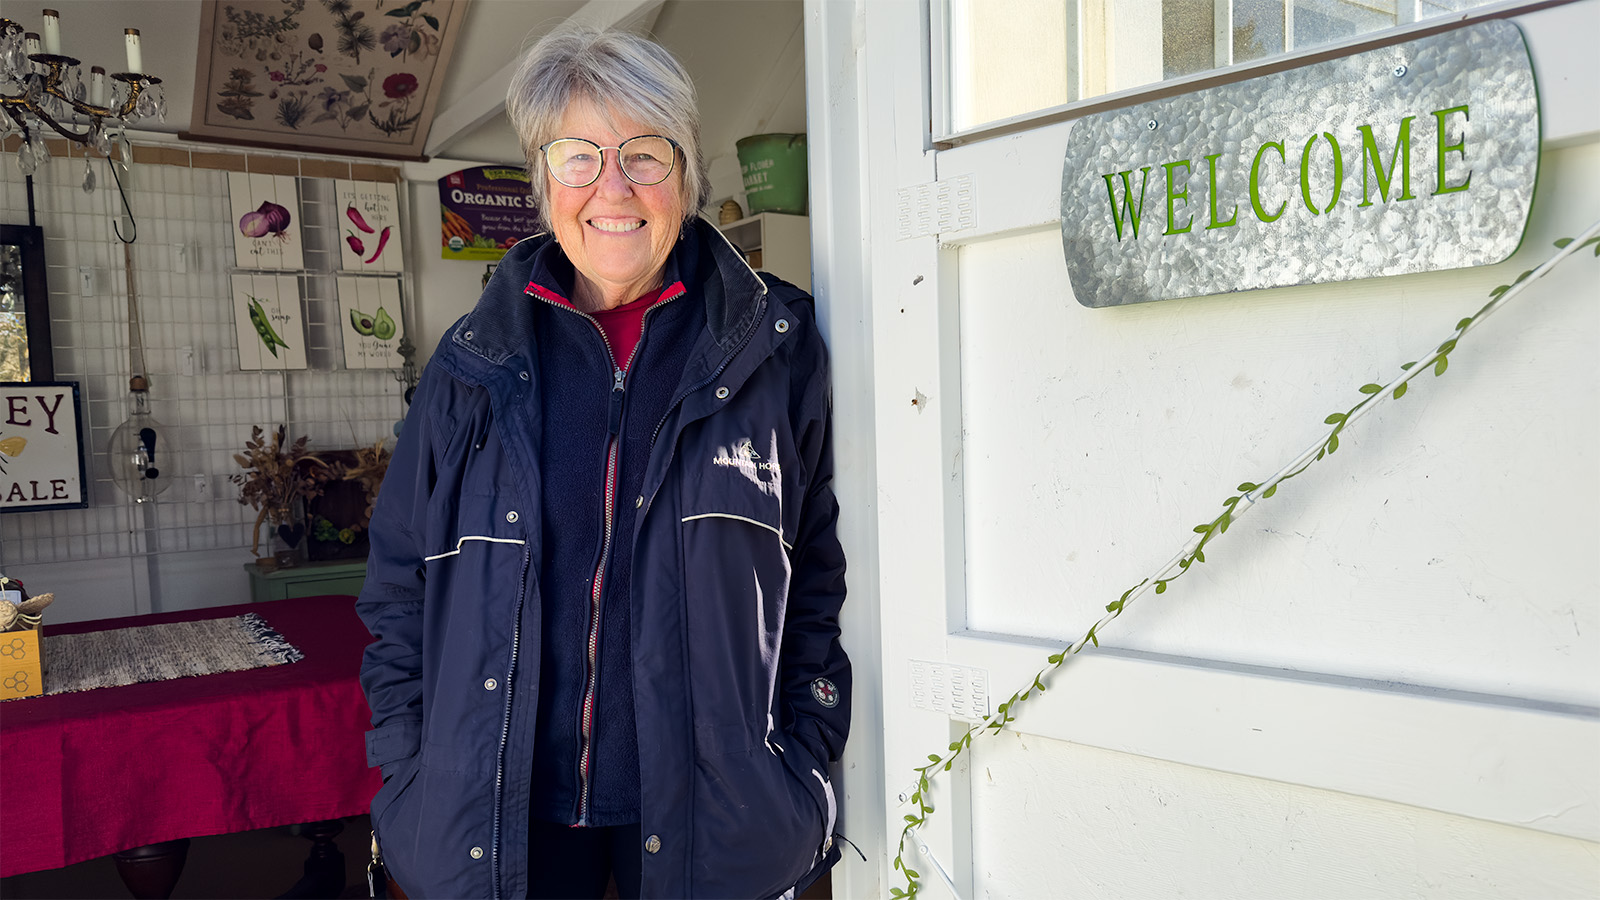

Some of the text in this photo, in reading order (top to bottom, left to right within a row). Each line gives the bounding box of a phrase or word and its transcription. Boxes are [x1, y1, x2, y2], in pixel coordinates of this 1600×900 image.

[1101, 104, 1473, 243] WELCOME
[360, 193, 391, 202] GETTING
[451, 189, 522, 208] ORGANIC
[525, 195, 535, 208] S
[713, 456, 757, 470] MOUNTAIN
[0, 479, 69, 502] ALE
